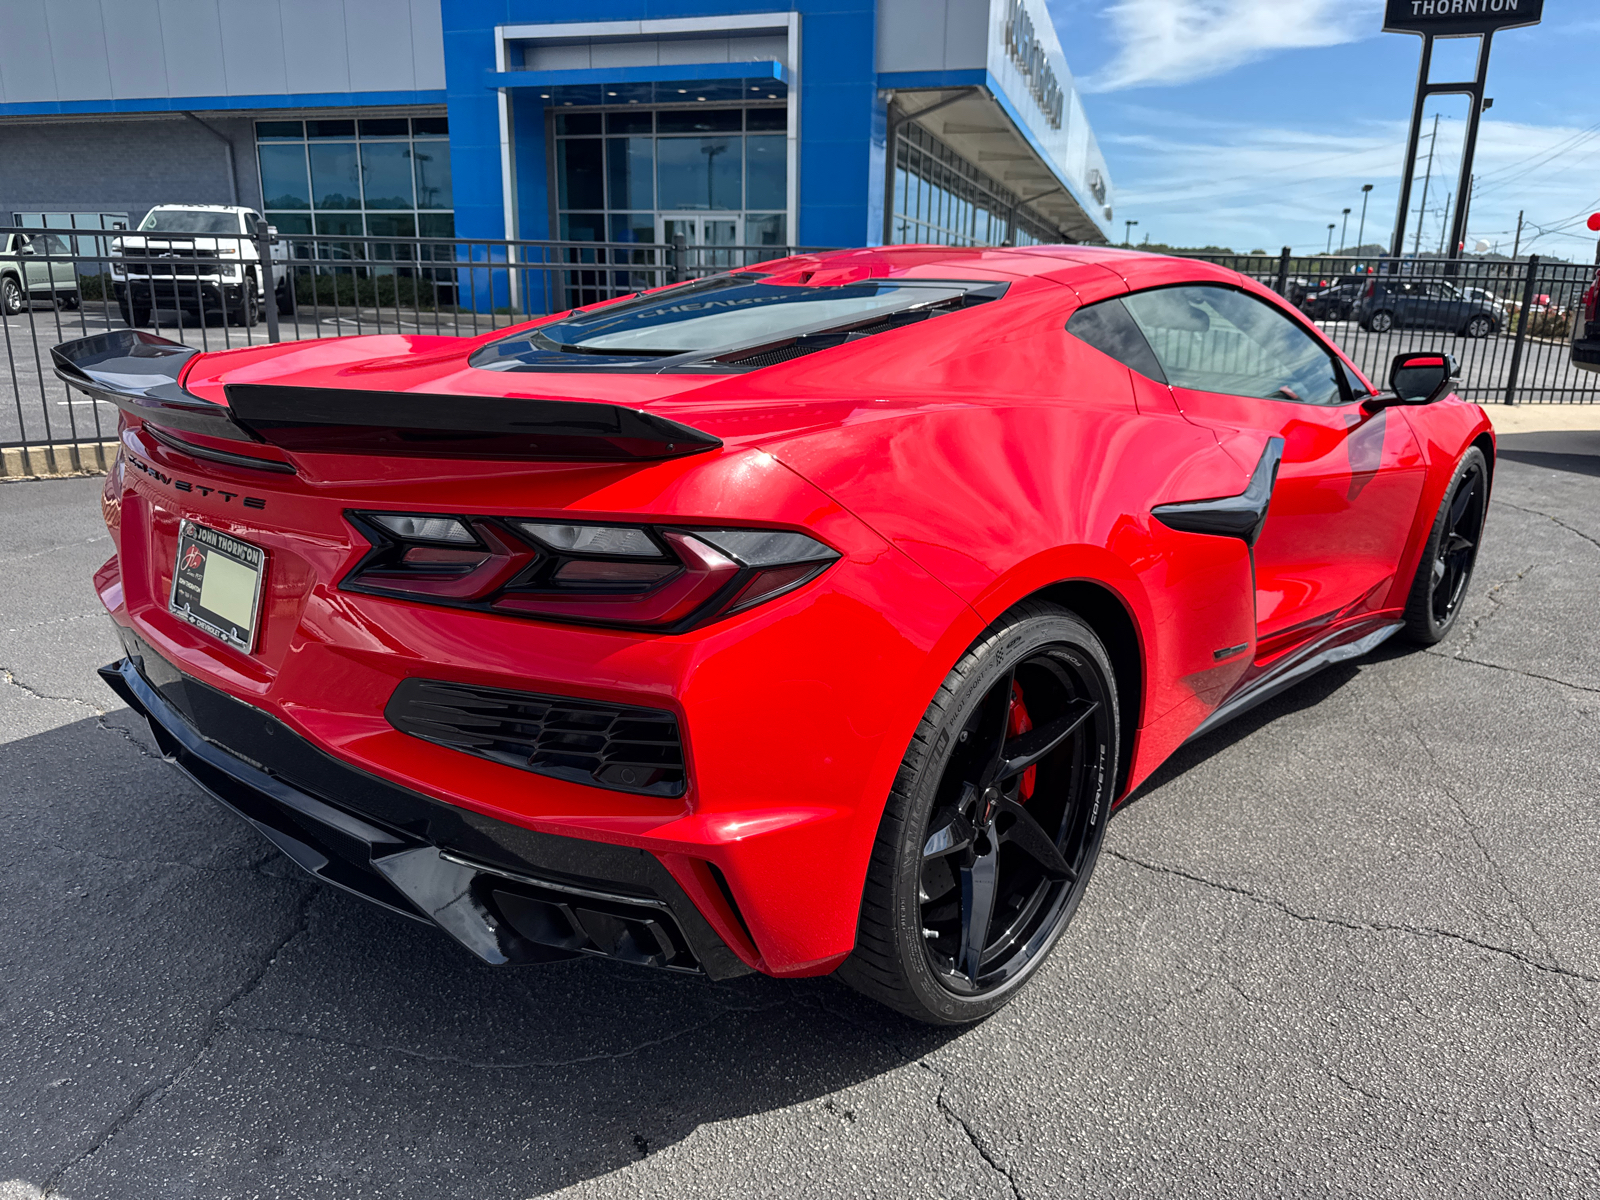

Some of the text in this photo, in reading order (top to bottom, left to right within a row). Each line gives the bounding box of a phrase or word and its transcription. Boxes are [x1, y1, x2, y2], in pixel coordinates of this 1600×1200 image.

[1411, 0, 1518, 15] THORNTON
[128, 454, 266, 510] CORVETTE
[198, 528, 217, 546] JOHN
[196, 619, 221, 637] CHEVROLET
[907, 727, 950, 844] MICHELIN
[949, 701, 967, 726] PILOT
[965, 672, 986, 698] SPORT
[1090, 744, 1106, 826] CORVETTE
